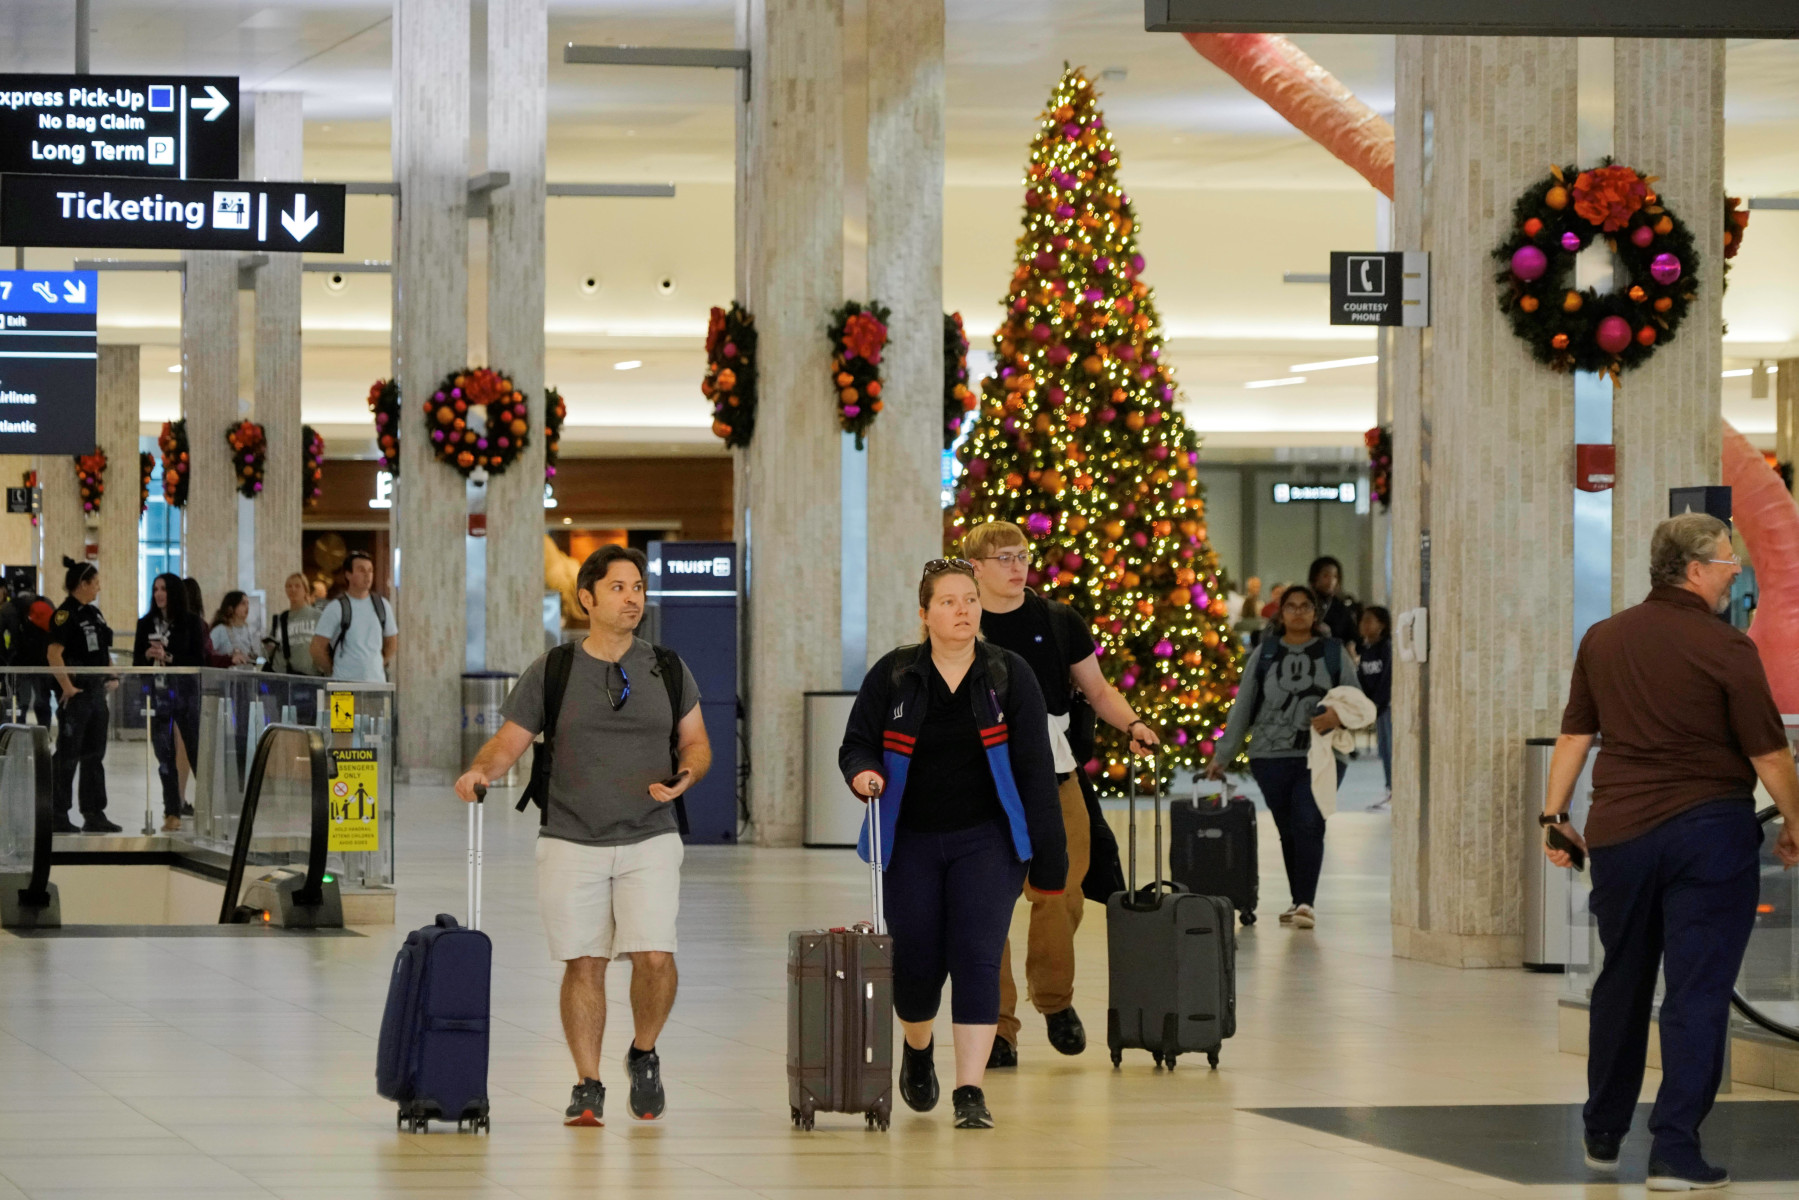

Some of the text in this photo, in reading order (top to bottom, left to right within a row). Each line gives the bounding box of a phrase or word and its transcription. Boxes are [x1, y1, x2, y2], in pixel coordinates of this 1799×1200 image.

[69, 87, 145, 111] Pick-Up
[39, 113, 145, 133] No Bag Claim
[32, 140, 85, 165] Long
[91, 140, 145, 161] Term
[56, 191, 205, 229] Ticketing
[1343, 302, 1389, 312] COURTESY
[7, 315, 27, 328] Exit
[1351, 313, 1381, 321] PHONE
[667, 560, 713, 573] TRUIST
